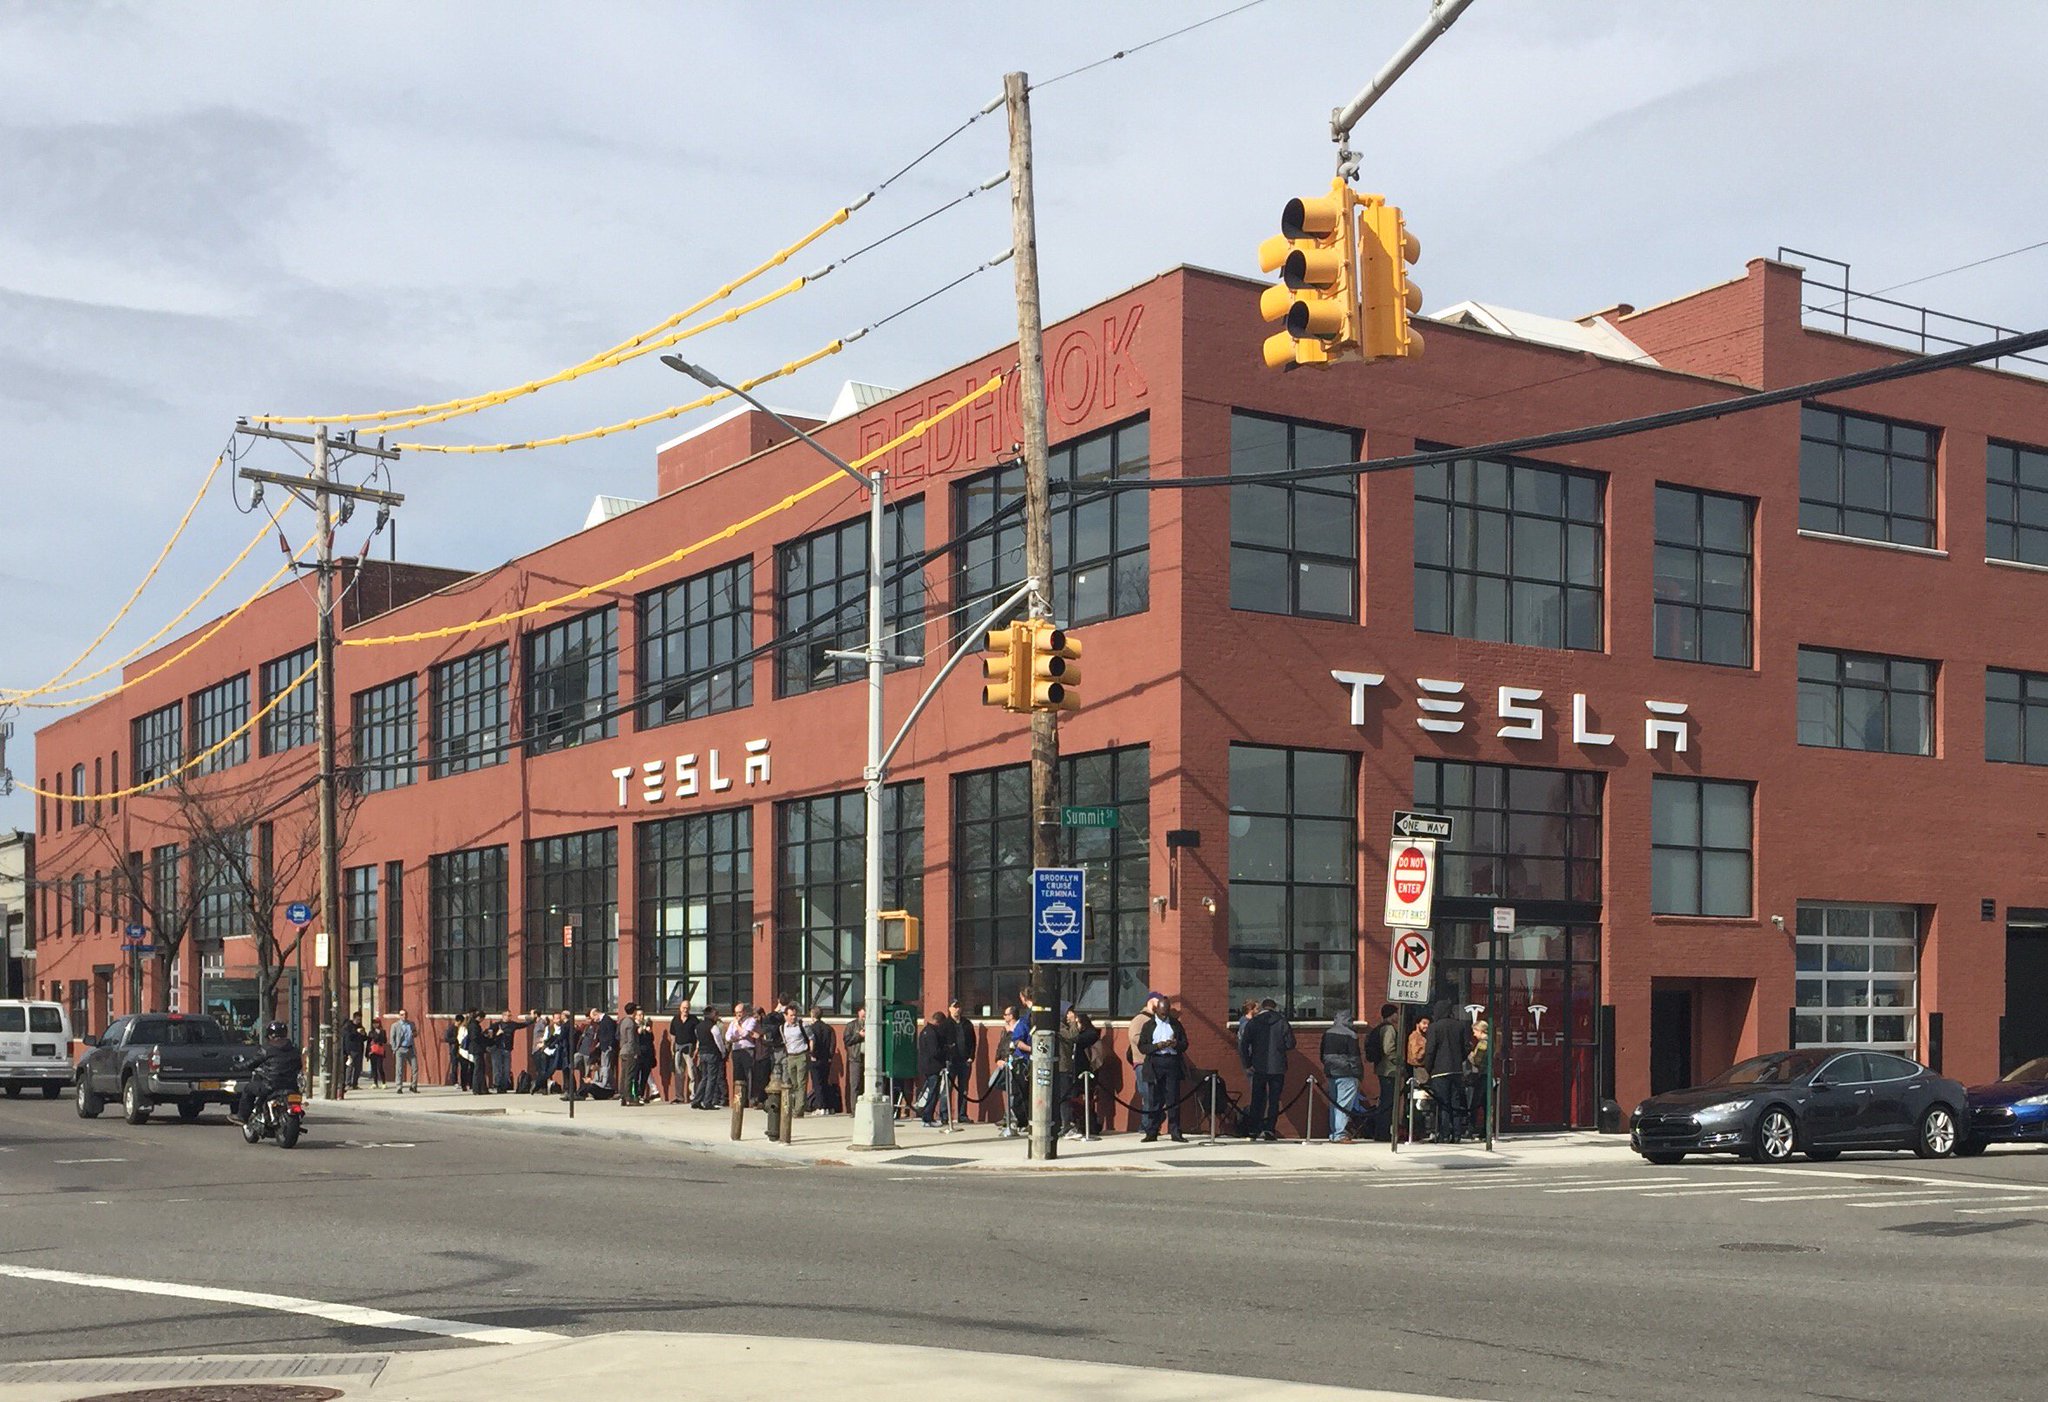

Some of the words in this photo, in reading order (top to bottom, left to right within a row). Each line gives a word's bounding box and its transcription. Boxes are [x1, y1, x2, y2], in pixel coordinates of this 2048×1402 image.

[1331, 670, 1688, 752] TESLA
[611, 738, 771, 808] TESLA
[1066, 809, 1105, 824] Summit
[1402, 820, 1420, 831] ONE
[1427, 823, 1445, 833] WAY
[1399, 857, 1409, 868] DO
[1410, 857, 1424, 868] NOT
[1039, 874, 1079, 882] BROOKLYN
[1041, 890, 1077, 898] TERMINAL
[1398, 883, 1421, 894] ENTER
[1389, 909, 1409, 918] EXCEPT
[1410, 910, 1427, 919] BIKES
[1396, 980, 1422, 988] EXCEPT
[1398, 990, 1419, 998] BIKES
